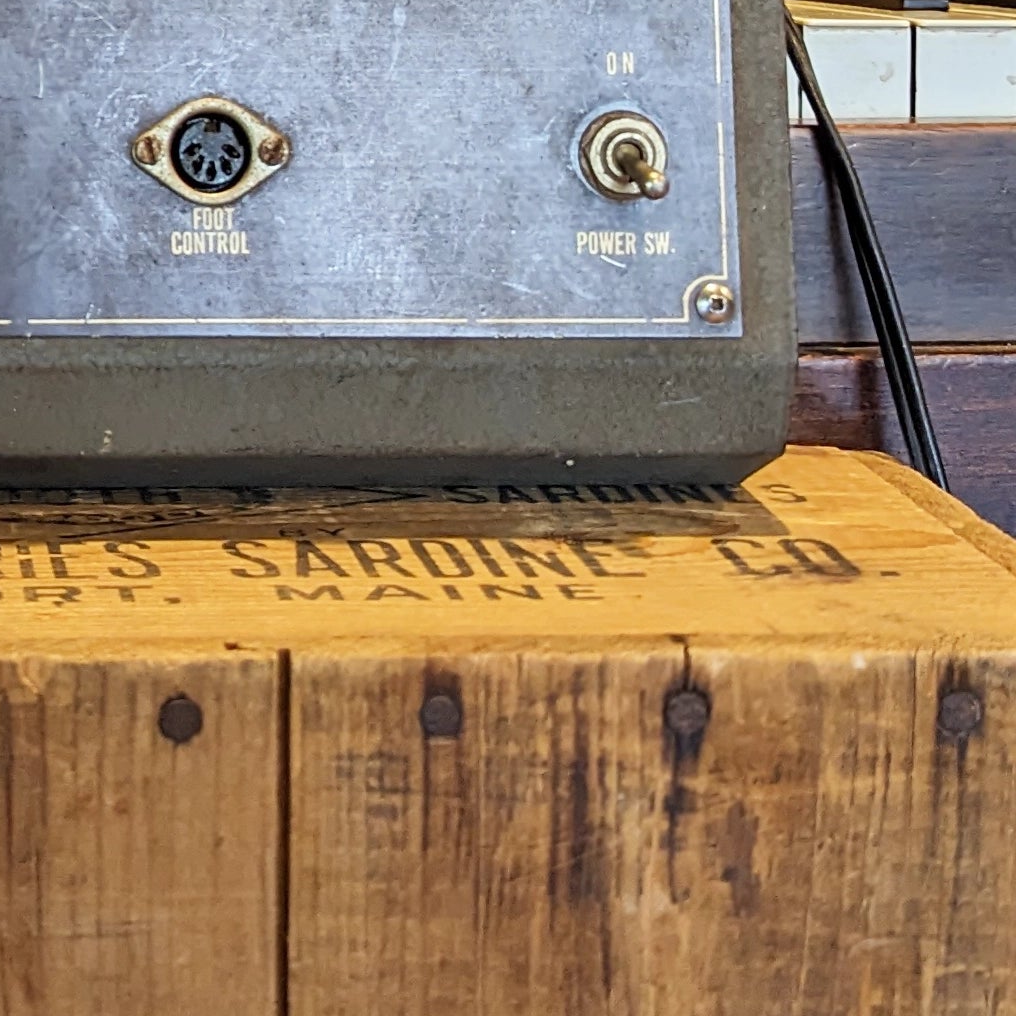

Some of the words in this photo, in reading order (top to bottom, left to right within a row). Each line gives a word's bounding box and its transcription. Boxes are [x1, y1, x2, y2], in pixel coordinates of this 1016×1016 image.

[606, 51, 635, 75] ON
[193, 207, 235, 230] FOOT
[170, 231, 249, 255] CONTROL
[577, 232, 636, 255] POWER
[644, 232, 676, 255] SW.
[443, 484, 808, 504] SARDINES
[229, 538, 647, 581] SARDINE
